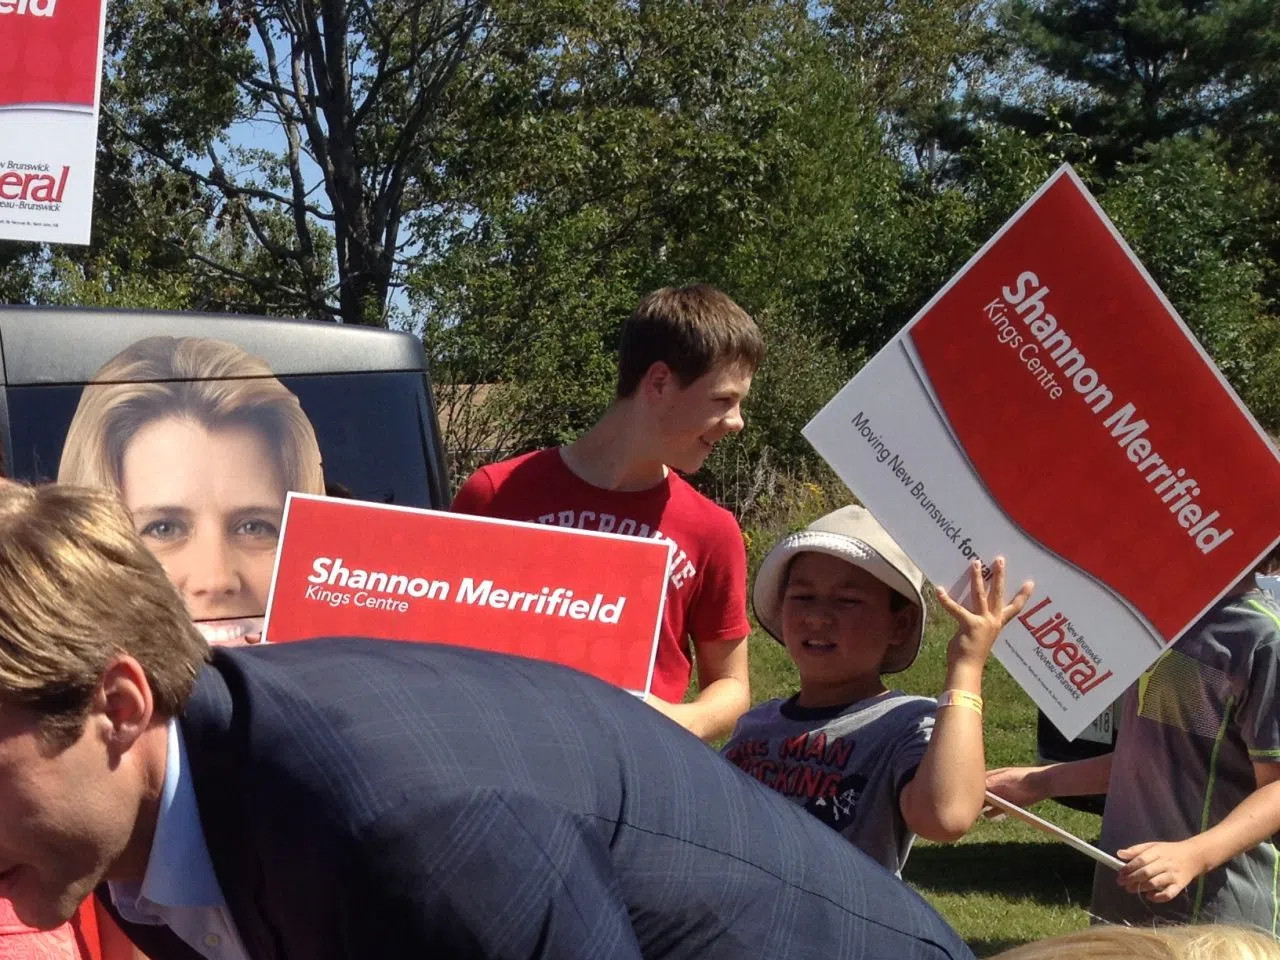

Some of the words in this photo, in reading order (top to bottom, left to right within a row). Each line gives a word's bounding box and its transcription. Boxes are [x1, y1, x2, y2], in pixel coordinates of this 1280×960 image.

[7, 160, 50, 172] Brunswick
[983, 297, 1023, 348] Kings
[1019, 343, 1063, 400] Centre
[1002, 270, 1114, 414] Shannon
[1103, 402, 1234, 555] Merrifield
[851, 411, 891, 463] Moving
[887, 454, 915, 487] New
[910, 481, 962, 544] Brunswick
[304, 585, 351, 607] Kings
[353, 591, 410, 613] Centre
[308, 556, 450, 601] Shannon
[455, 576, 626, 625] Merrifield
[1017, 596, 1113, 696] Liberal
[778, 730, 857, 770] MAN
